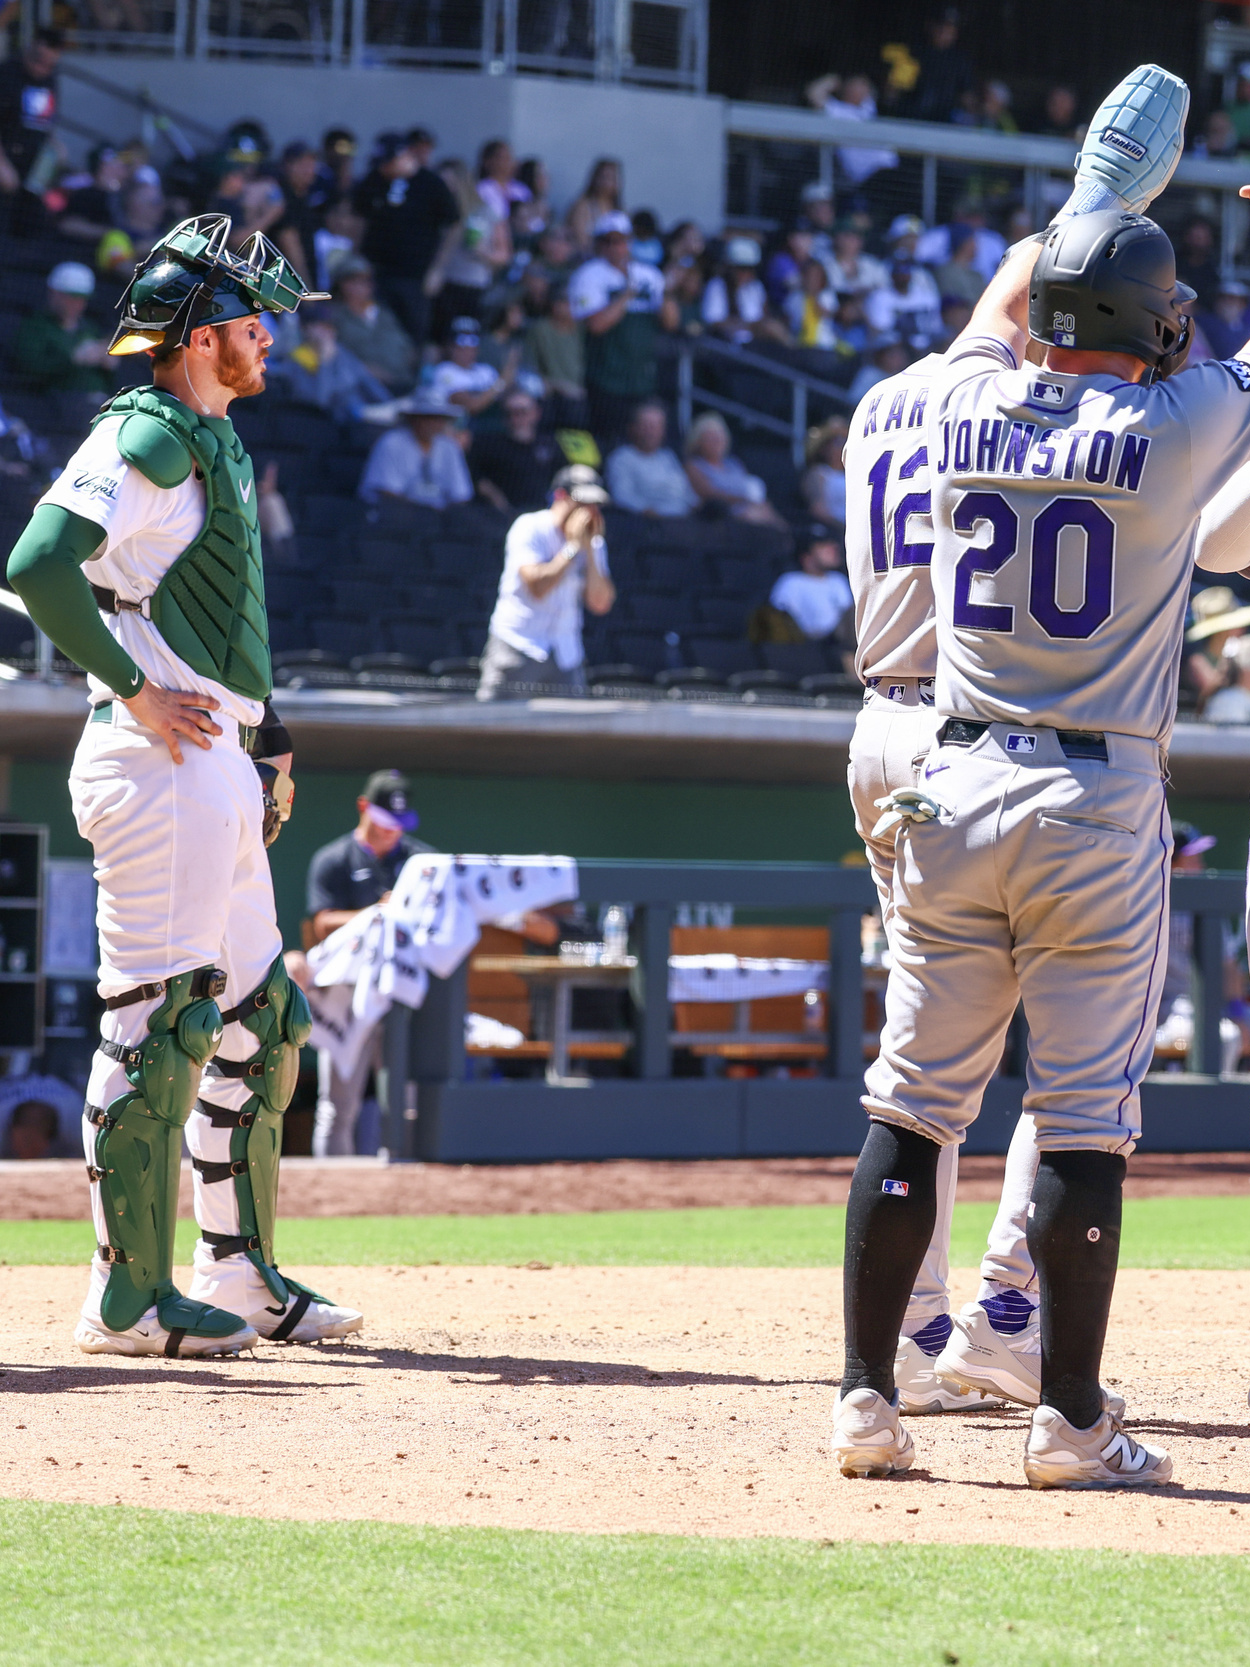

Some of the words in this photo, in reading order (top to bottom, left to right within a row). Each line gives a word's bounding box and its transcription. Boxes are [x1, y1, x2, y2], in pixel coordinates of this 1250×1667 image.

[1053, 311, 1075, 332] 20
[937, 418, 1151, 494] JOHNSTON
[867, 445, 935, 576] 12
[951, 490, 1116, 640] 20
